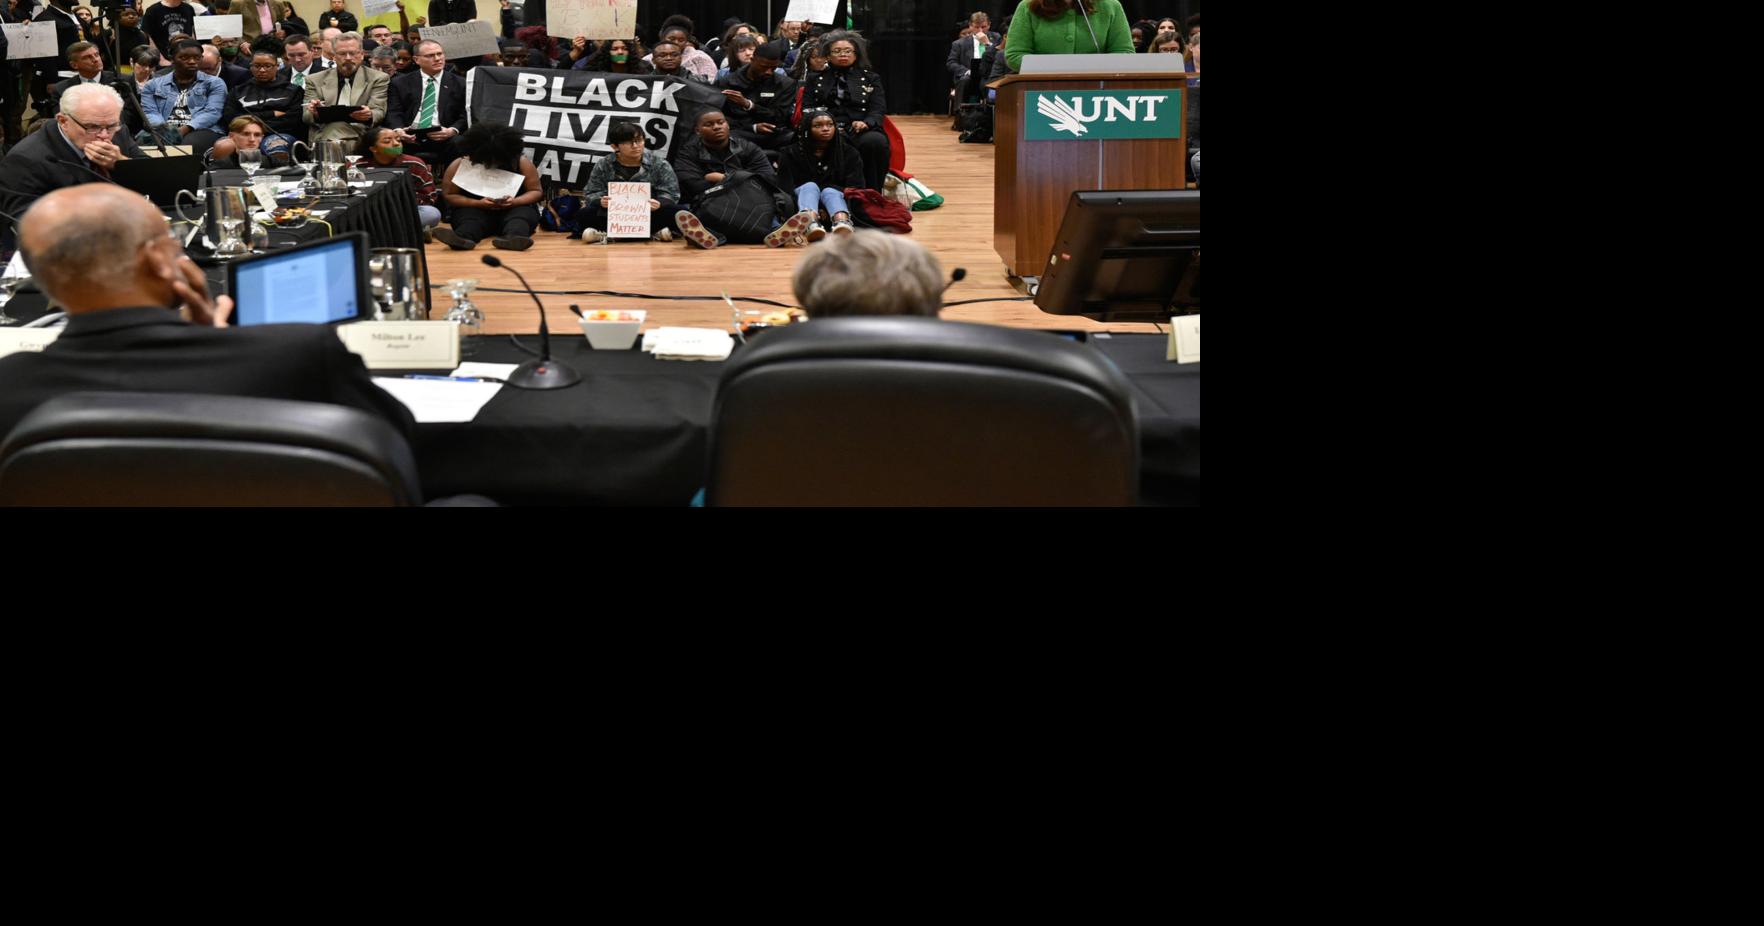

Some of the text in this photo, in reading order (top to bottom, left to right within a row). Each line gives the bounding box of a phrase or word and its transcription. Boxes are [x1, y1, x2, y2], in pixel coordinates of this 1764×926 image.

[514, 72, 687, 113] BLACK
[1071, 95, 1167, 122] UNT
[609, 183, 648, 195] BLACK
[610, 223, 646, 234] MATTER
